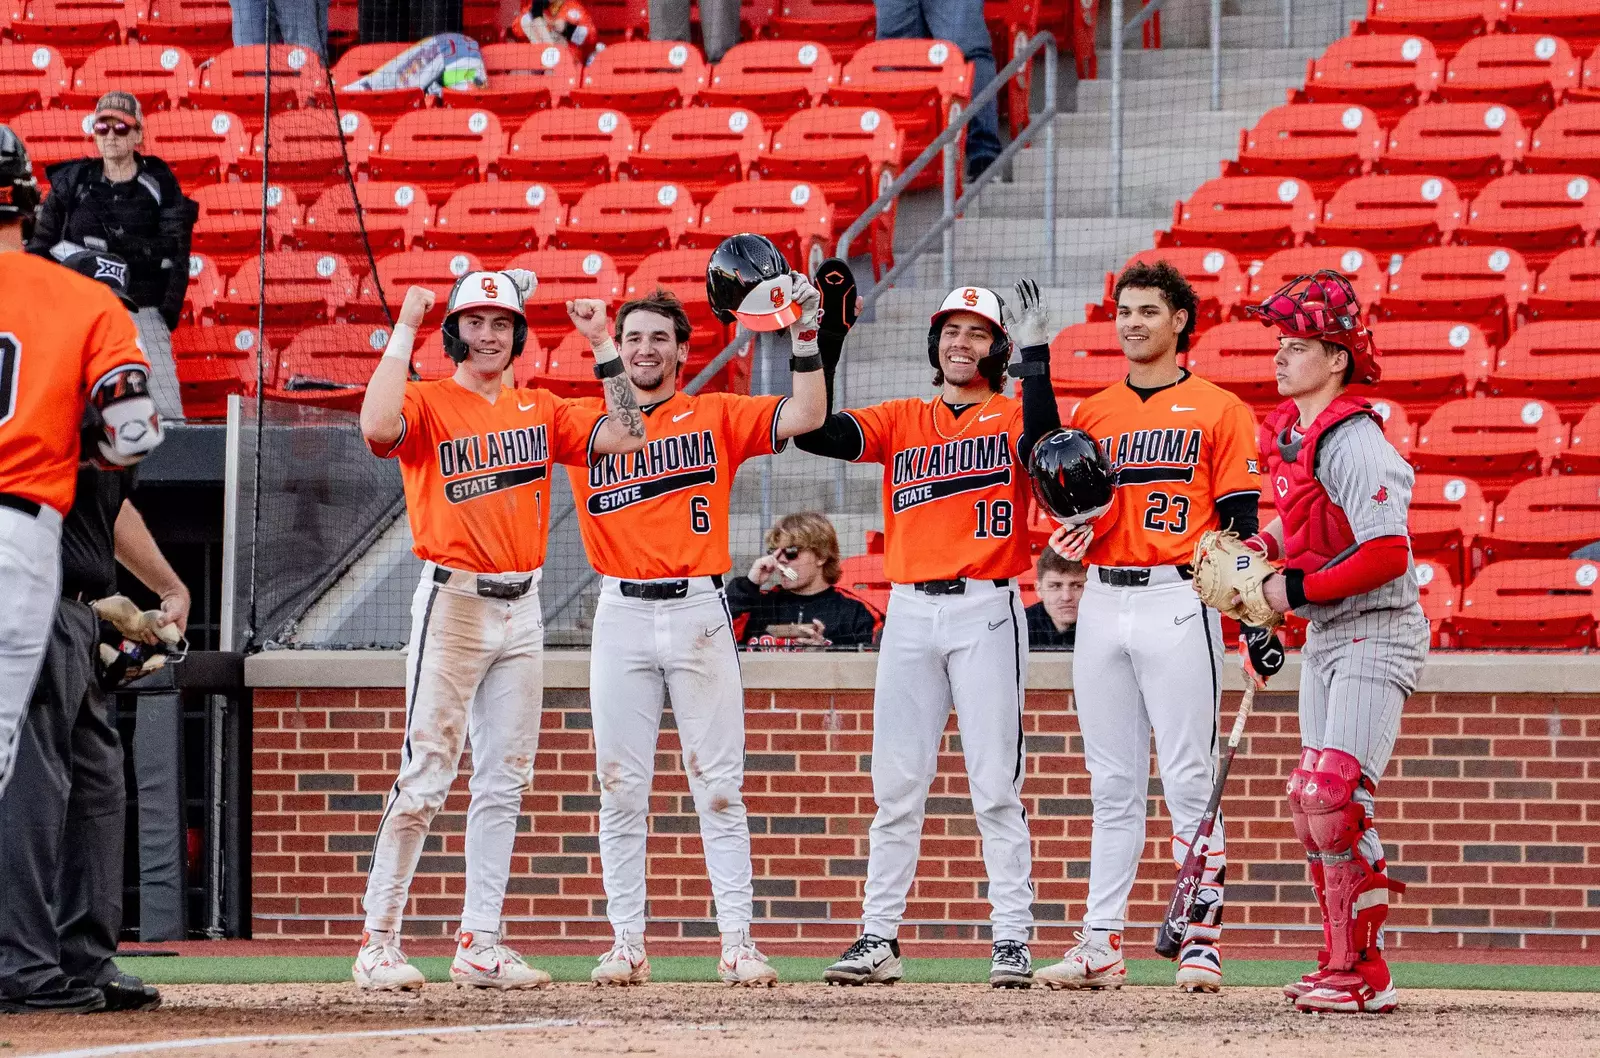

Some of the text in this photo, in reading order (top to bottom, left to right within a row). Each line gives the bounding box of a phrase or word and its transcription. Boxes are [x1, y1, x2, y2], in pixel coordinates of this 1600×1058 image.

[892, 431, 1013, 487] OKLAHOMA
[452, 476, 498, 499] STATE
[600, 486, 642, 510] STATE
[898, 485, 933, 508] STATE
[689, 495, 712, 534] 6
[973, 499, 1014, 539] 18
[1143, 491, 1190, 535] 23
